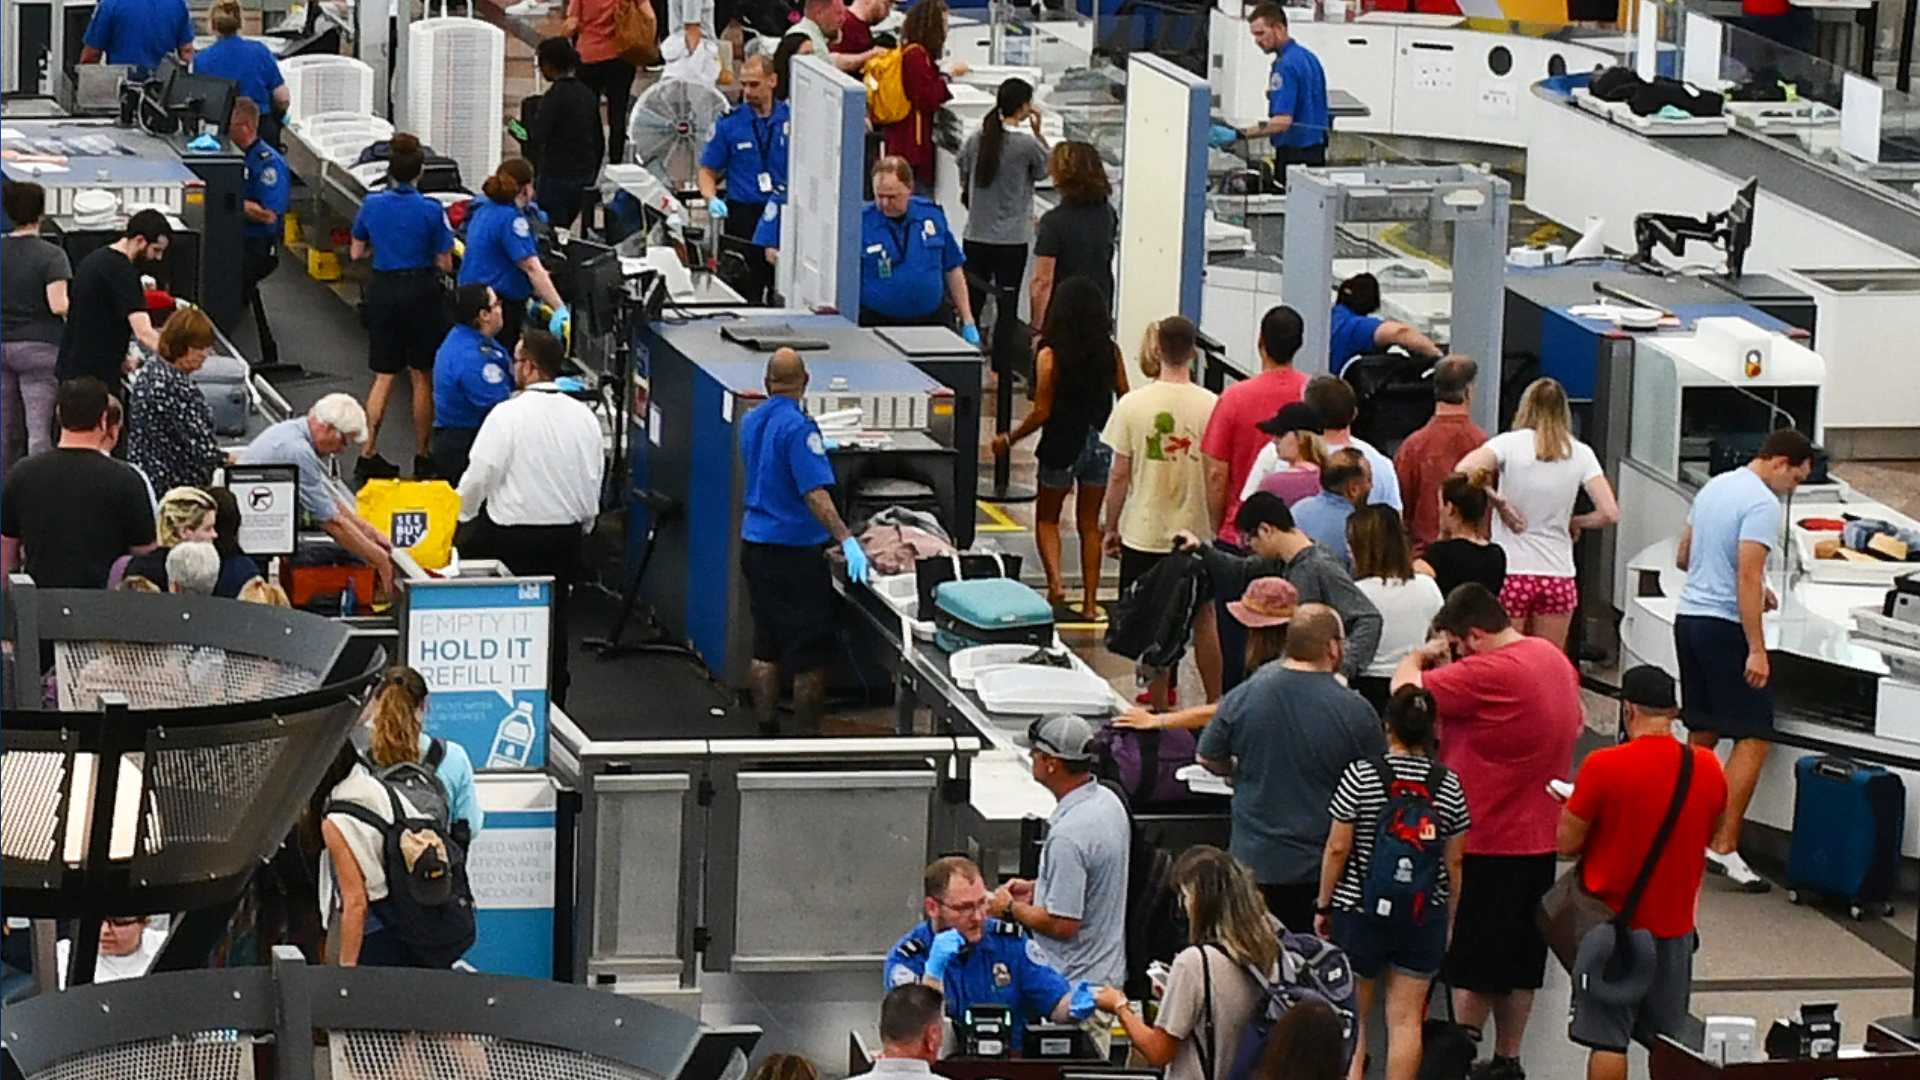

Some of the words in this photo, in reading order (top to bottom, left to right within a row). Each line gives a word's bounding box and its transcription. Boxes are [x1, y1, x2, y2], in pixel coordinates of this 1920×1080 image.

[397, 524, 422, 536] BUY
[420, 613, 504, 636] EMPTY
[512, 611, 532, 631] IT
[420, 639, 498, 661] HOLD
[507, 637, 532, 659] IT
[420, 664, 503, 686] REFILL
[511, 663, 532, 684] IT
